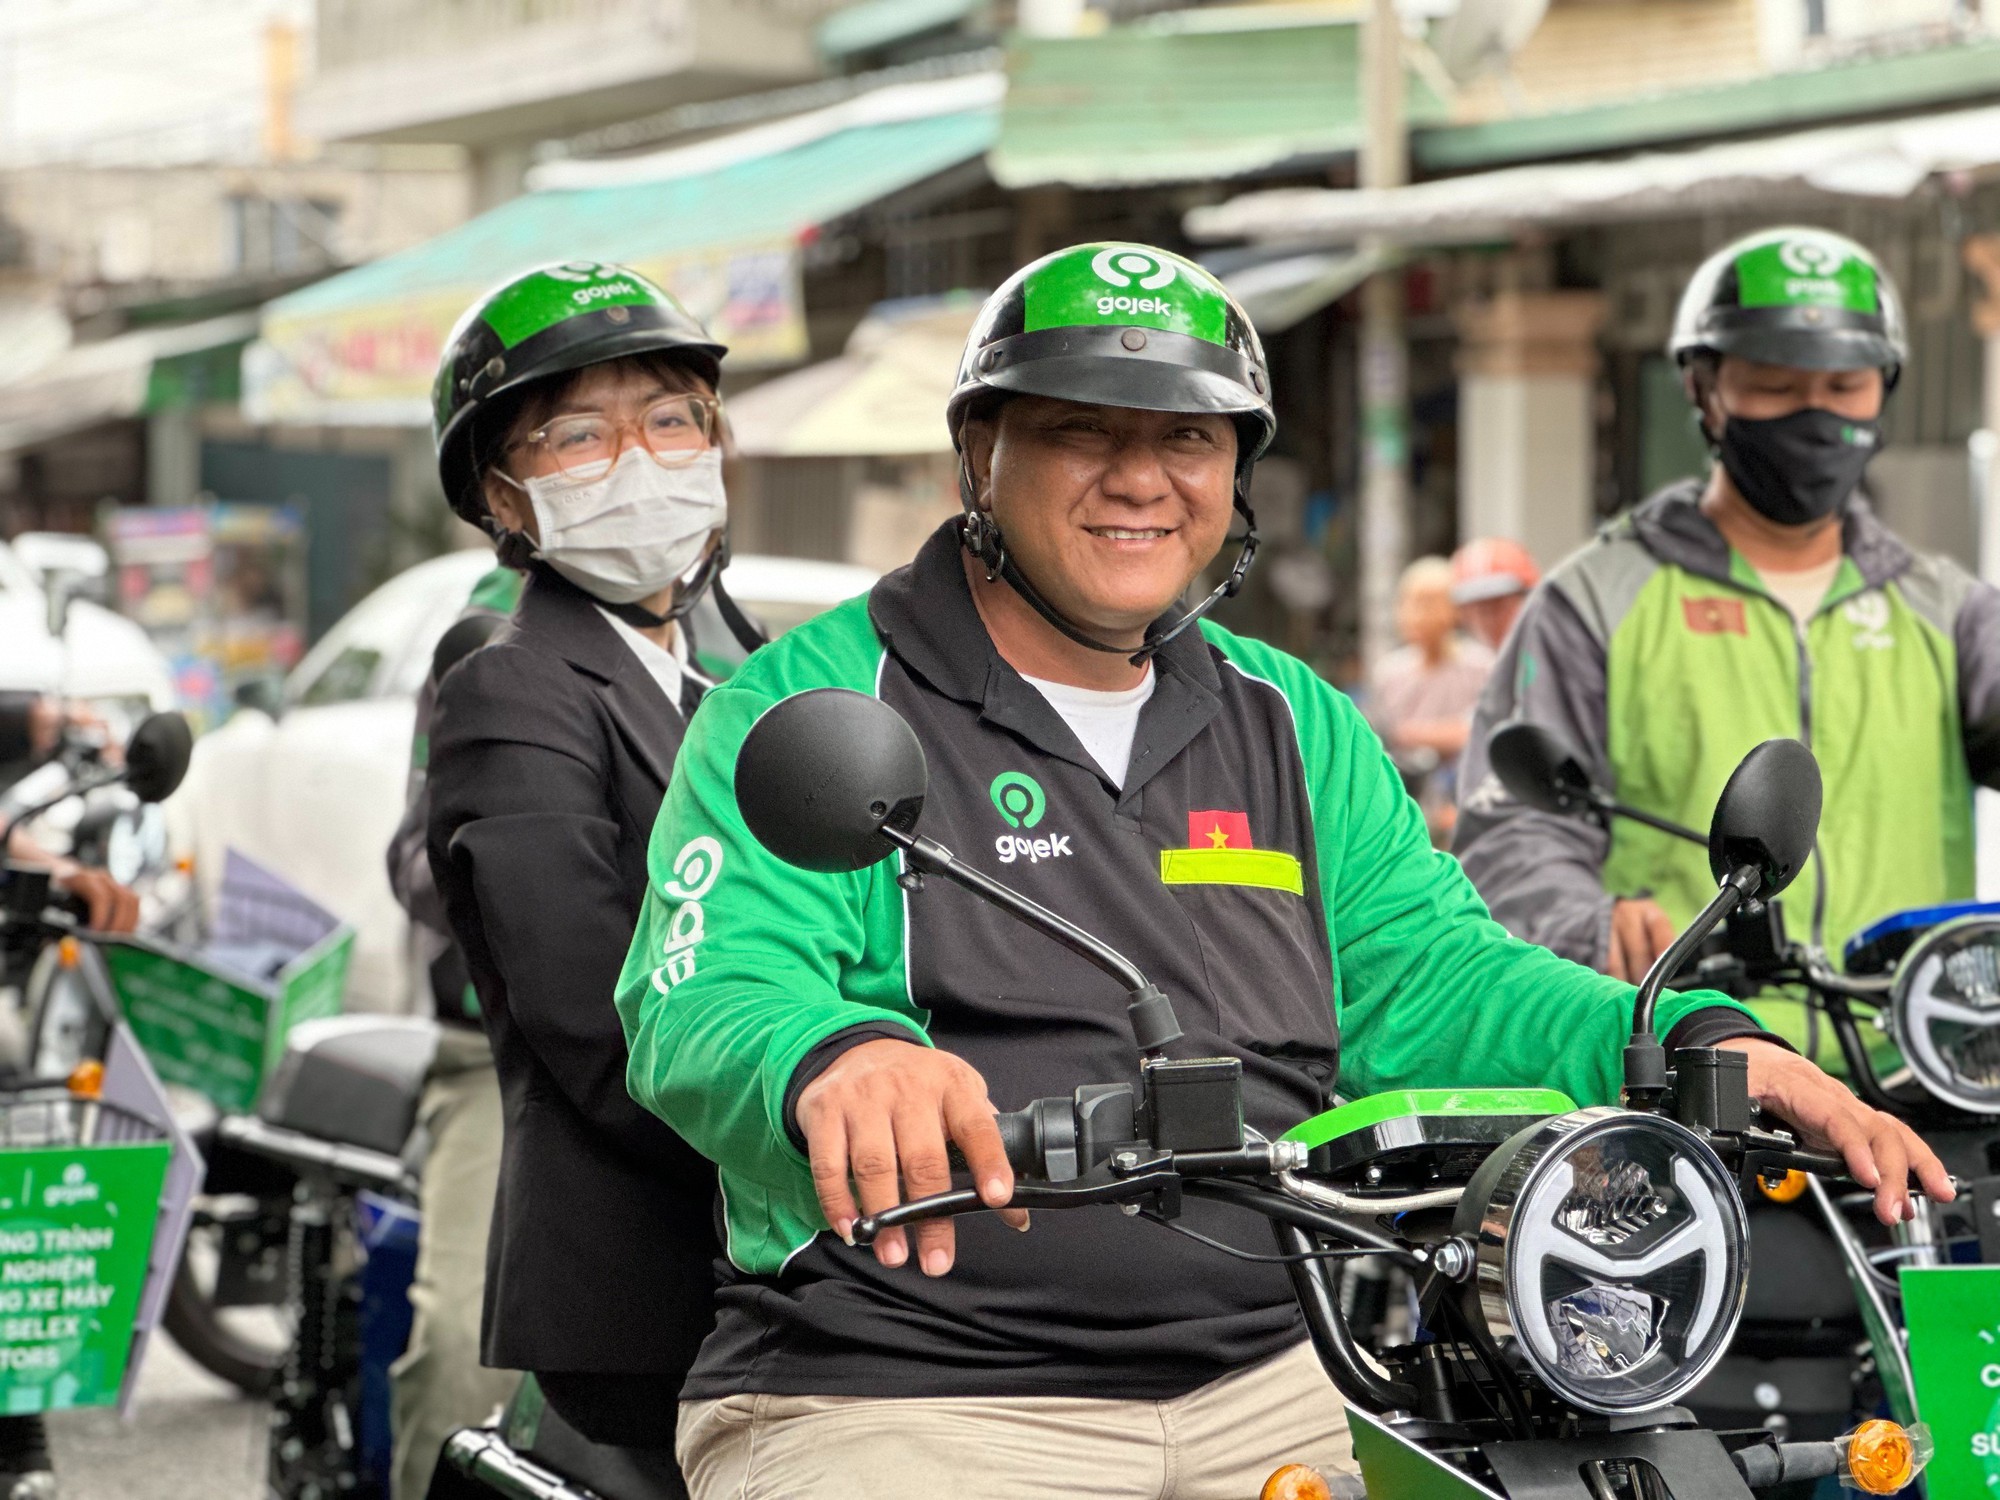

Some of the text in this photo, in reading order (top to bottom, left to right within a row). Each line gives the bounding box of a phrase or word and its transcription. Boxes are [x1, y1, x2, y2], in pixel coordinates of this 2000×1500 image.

[572, 281, 637, 304] gojek
[1096, 296, 1172, 317] gojek
[995, 833, 1073, 863] gojek
